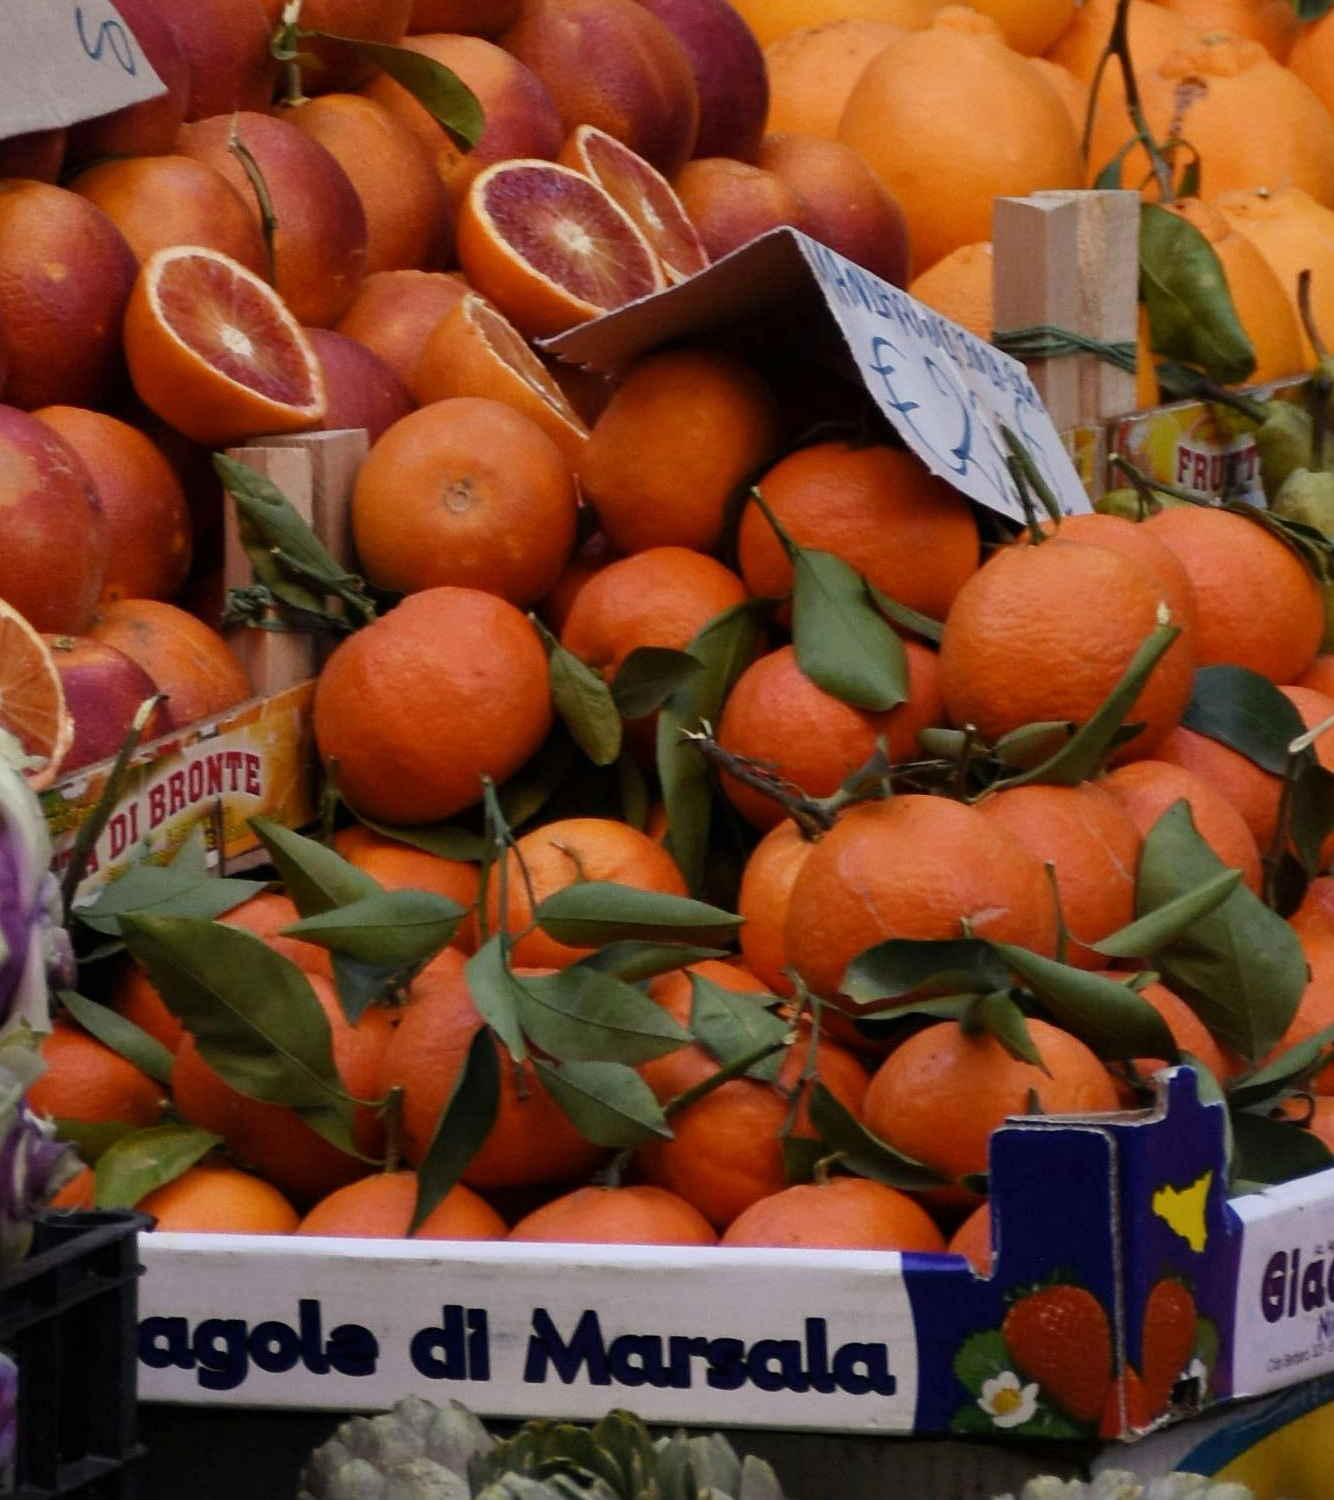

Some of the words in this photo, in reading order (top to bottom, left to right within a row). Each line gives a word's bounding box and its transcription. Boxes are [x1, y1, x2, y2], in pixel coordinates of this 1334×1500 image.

[108, 803, 139, 859] DI
[148, 751, 261, 830] BRONTE
[524, 1307, 897, 1397] Marsala
